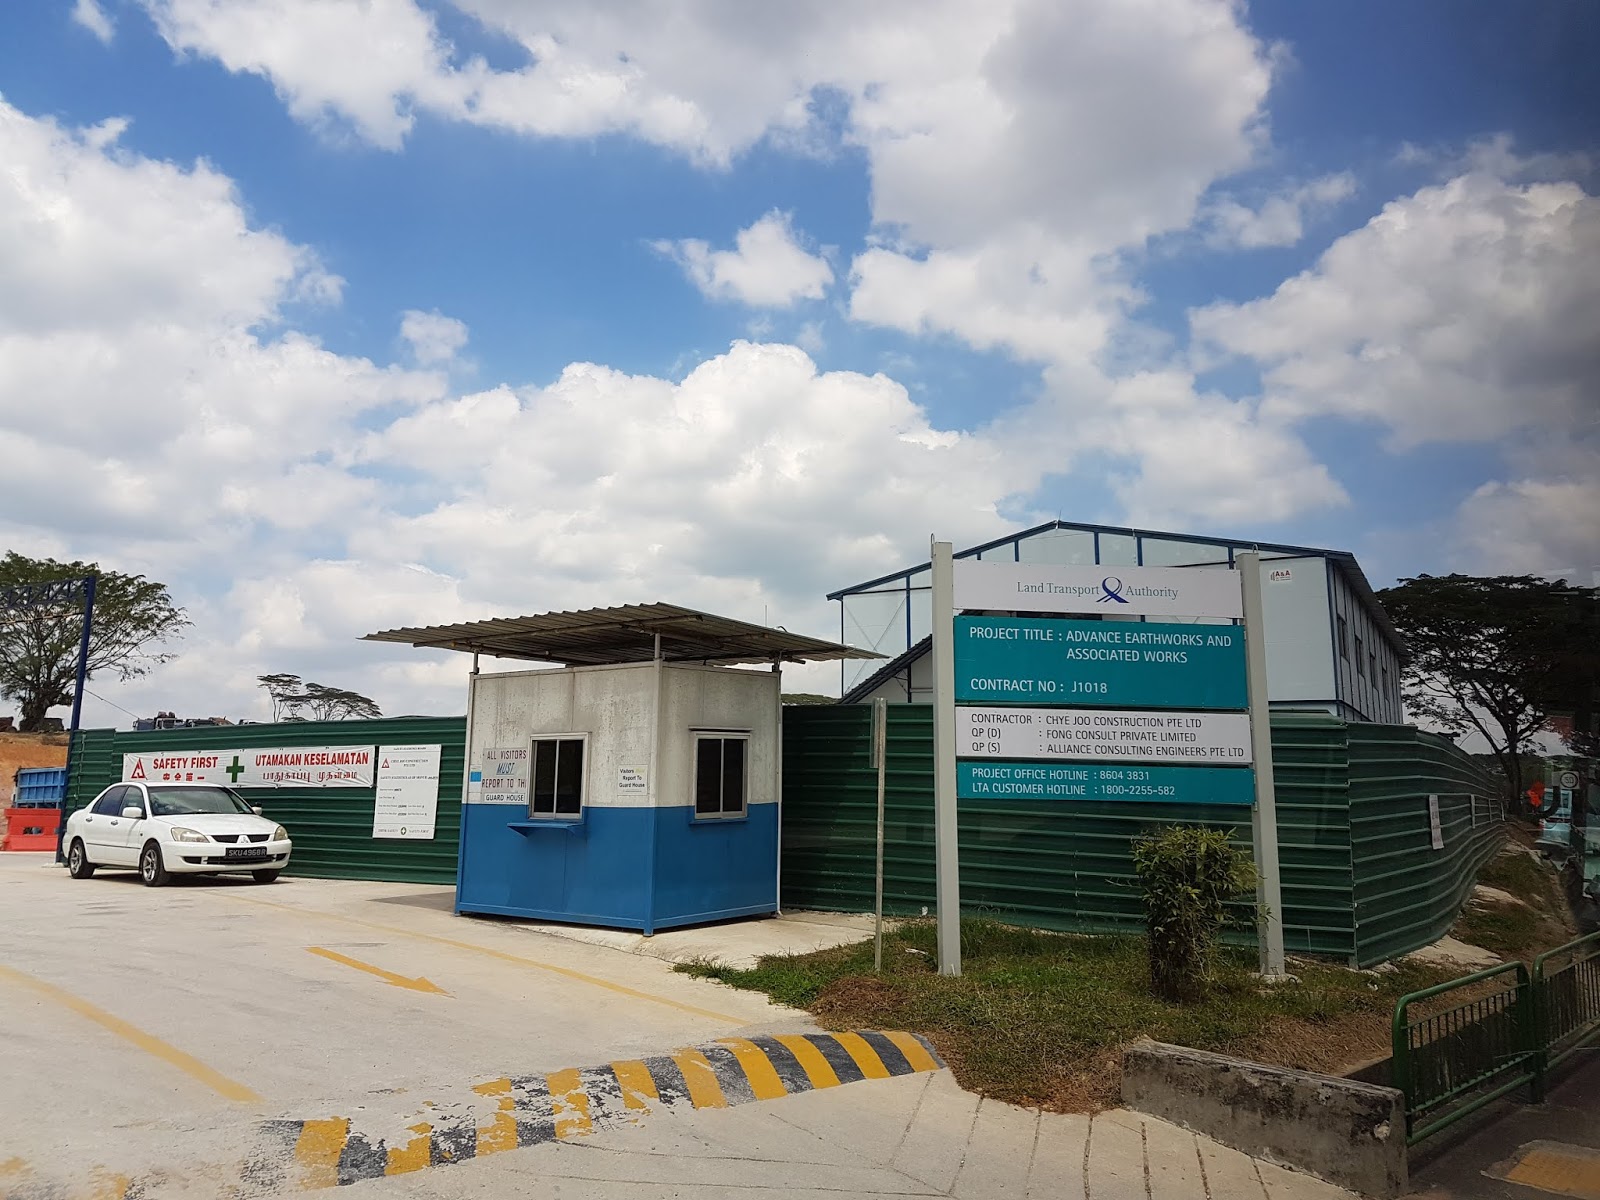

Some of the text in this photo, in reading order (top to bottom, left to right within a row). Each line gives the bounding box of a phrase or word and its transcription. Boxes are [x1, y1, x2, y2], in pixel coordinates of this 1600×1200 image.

[1017, 581, 1178, 600] Land Transport Authority
[969, 627, 1019, 640] PROJECT
[1024, 629, 1053, 641] TITLE
[1066, 631, 1121, 643] ADVANCE
[1125, 632, 1203, 646] EARTHWORKS
[1207, 635, 1231, 647] AND
[1066, 648, 1187, 663] ASSOCIATED WORKS
[970, 678, 1033, 692] CONTRACT
[1038, 680, 1056, 692] NO
[1071, 681, 1108, 693] J1018
[971, 714, 1032, 724] CONTRACTOR
[1046, 715, 1070, 725] CHYE
[1072, 716, 1091, 726] JOO
[1093, 716, 1164, 727] CONSTRUCTION
[1167, 718, 1183, 727] PTE
[1185, 718, 1202, 728] LTD
[971, 728, 985, 738] QP
[987, 728, 1001, 739] (D)
[1046, 730, 1073, 739] FONG
[1075, 730, 1118, 740] CONSULT
[1120, 731, 1158, 741] PRIVATE
[1160, 732, 1196, 742] LIMITED
[487, 750, 527, 760] ALL VISITORS
[972, 742, 985, 752] QP
[987, 742, 1001, 753] (S)
[1047, 744, 1092, 754] ALLIANCE
[1094, 745, 1153, 755] CONSULTING
[1156, 746, 1207, 756] ENGINEERS
[1210, 747, 1225, 756] PTE
[1228, 747, 1244, 757] LTD
[153, 757, 218, 769] SAFETY FIRST
[256, 752, 369, 766] UTAMAKAN KESELAMATAN
[497, 763, 515, 774] MUST
[972, 768, 1011, 779] PROJECT
[1014, 768, 1046, 779] OFFICE
[1050, 770, 1088, 780] HOTLINE
[1100, 770, 1123, 780] 8604
[1126, 771, 1149, 780] 3831
[482, 779, 503, 788] REPORT
[507, 779, 514, 788] TO
[972, 783, 989, 793] LTA
[992, 783, 1044, 794] CUSTOMER
[1046, 784, 1086, 795] HOTLINE
[1101, 786, 1175, 796] 1800-2255-582
